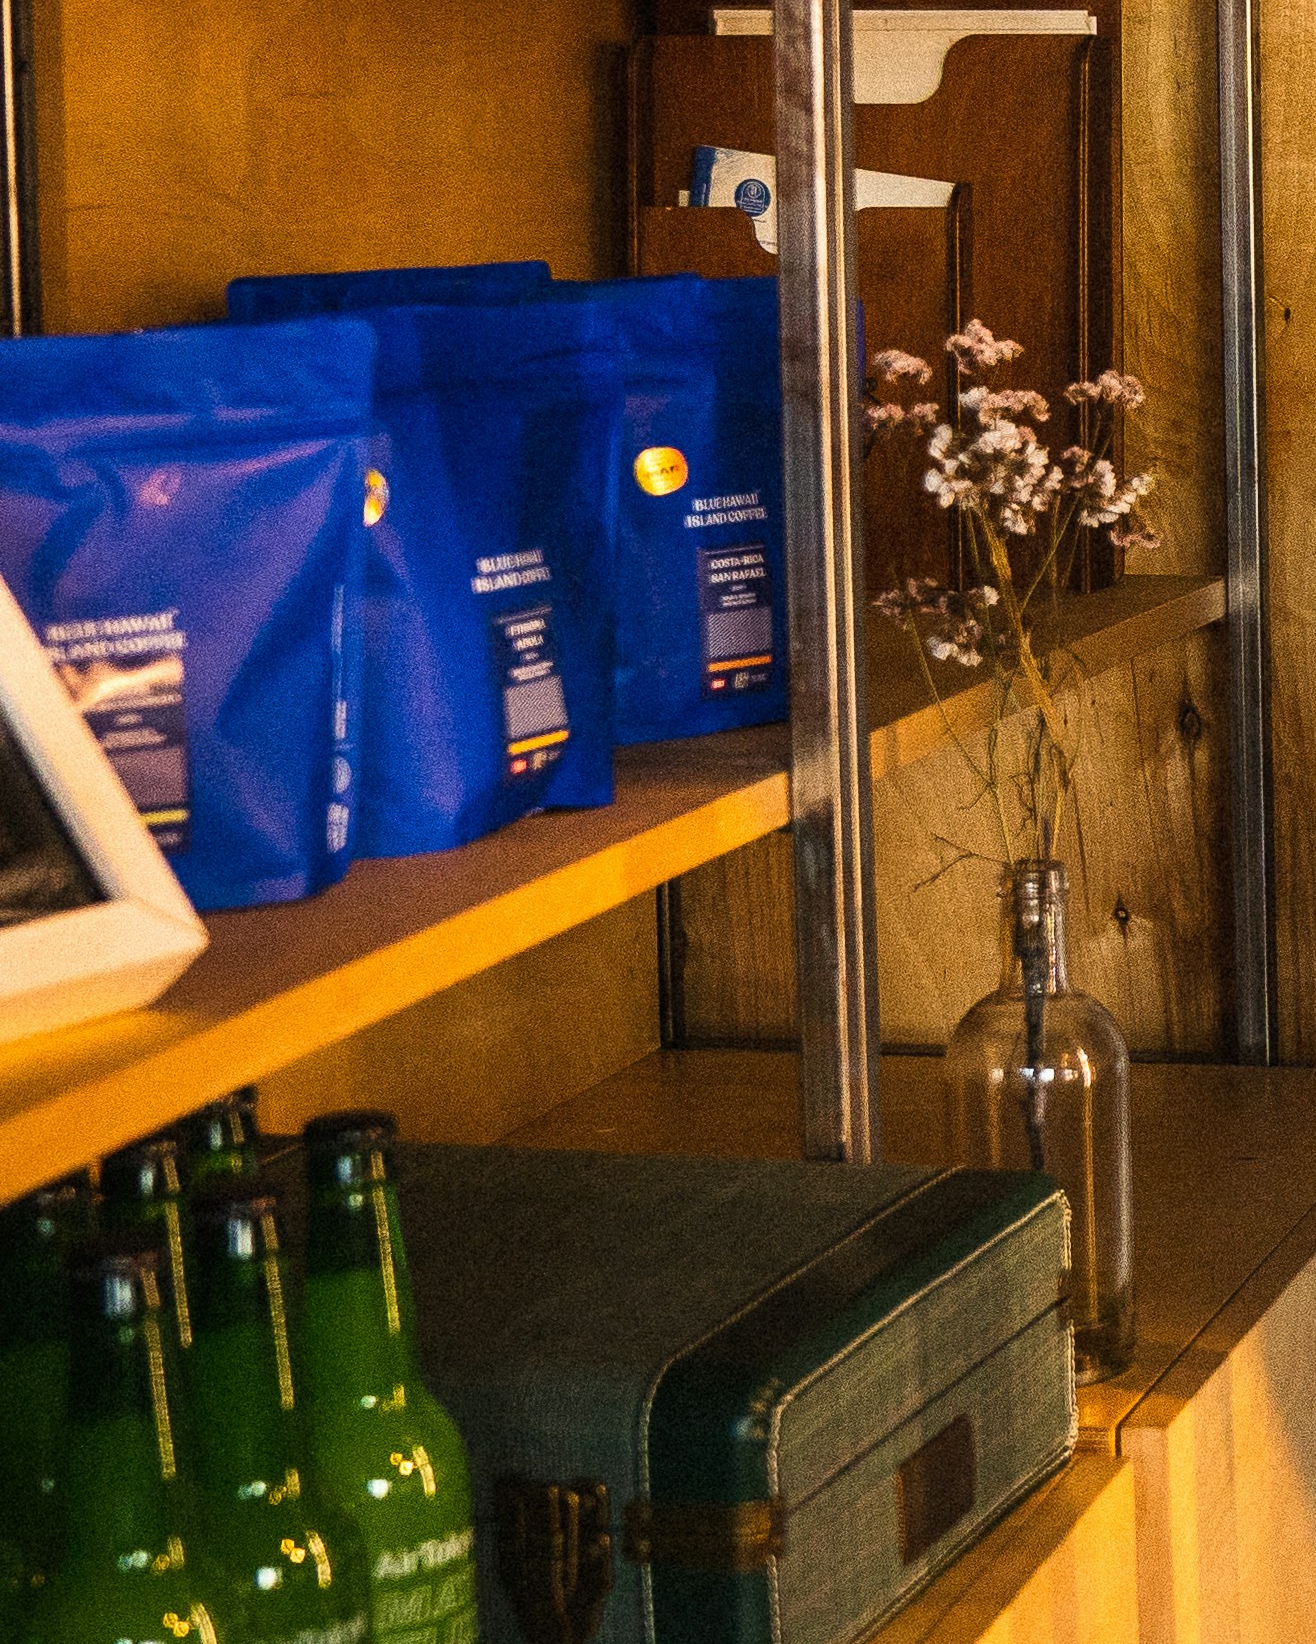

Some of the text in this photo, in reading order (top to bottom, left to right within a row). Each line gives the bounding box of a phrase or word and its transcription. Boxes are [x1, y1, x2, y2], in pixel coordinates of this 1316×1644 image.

[693, 493, 760, 512] BLUE HAWAII
[684, 509, 727, 528] ISLAND
[710, 554, 764, 570] COSTA-RICA
[710, 567, 766, 584] SAN RAFAEL
